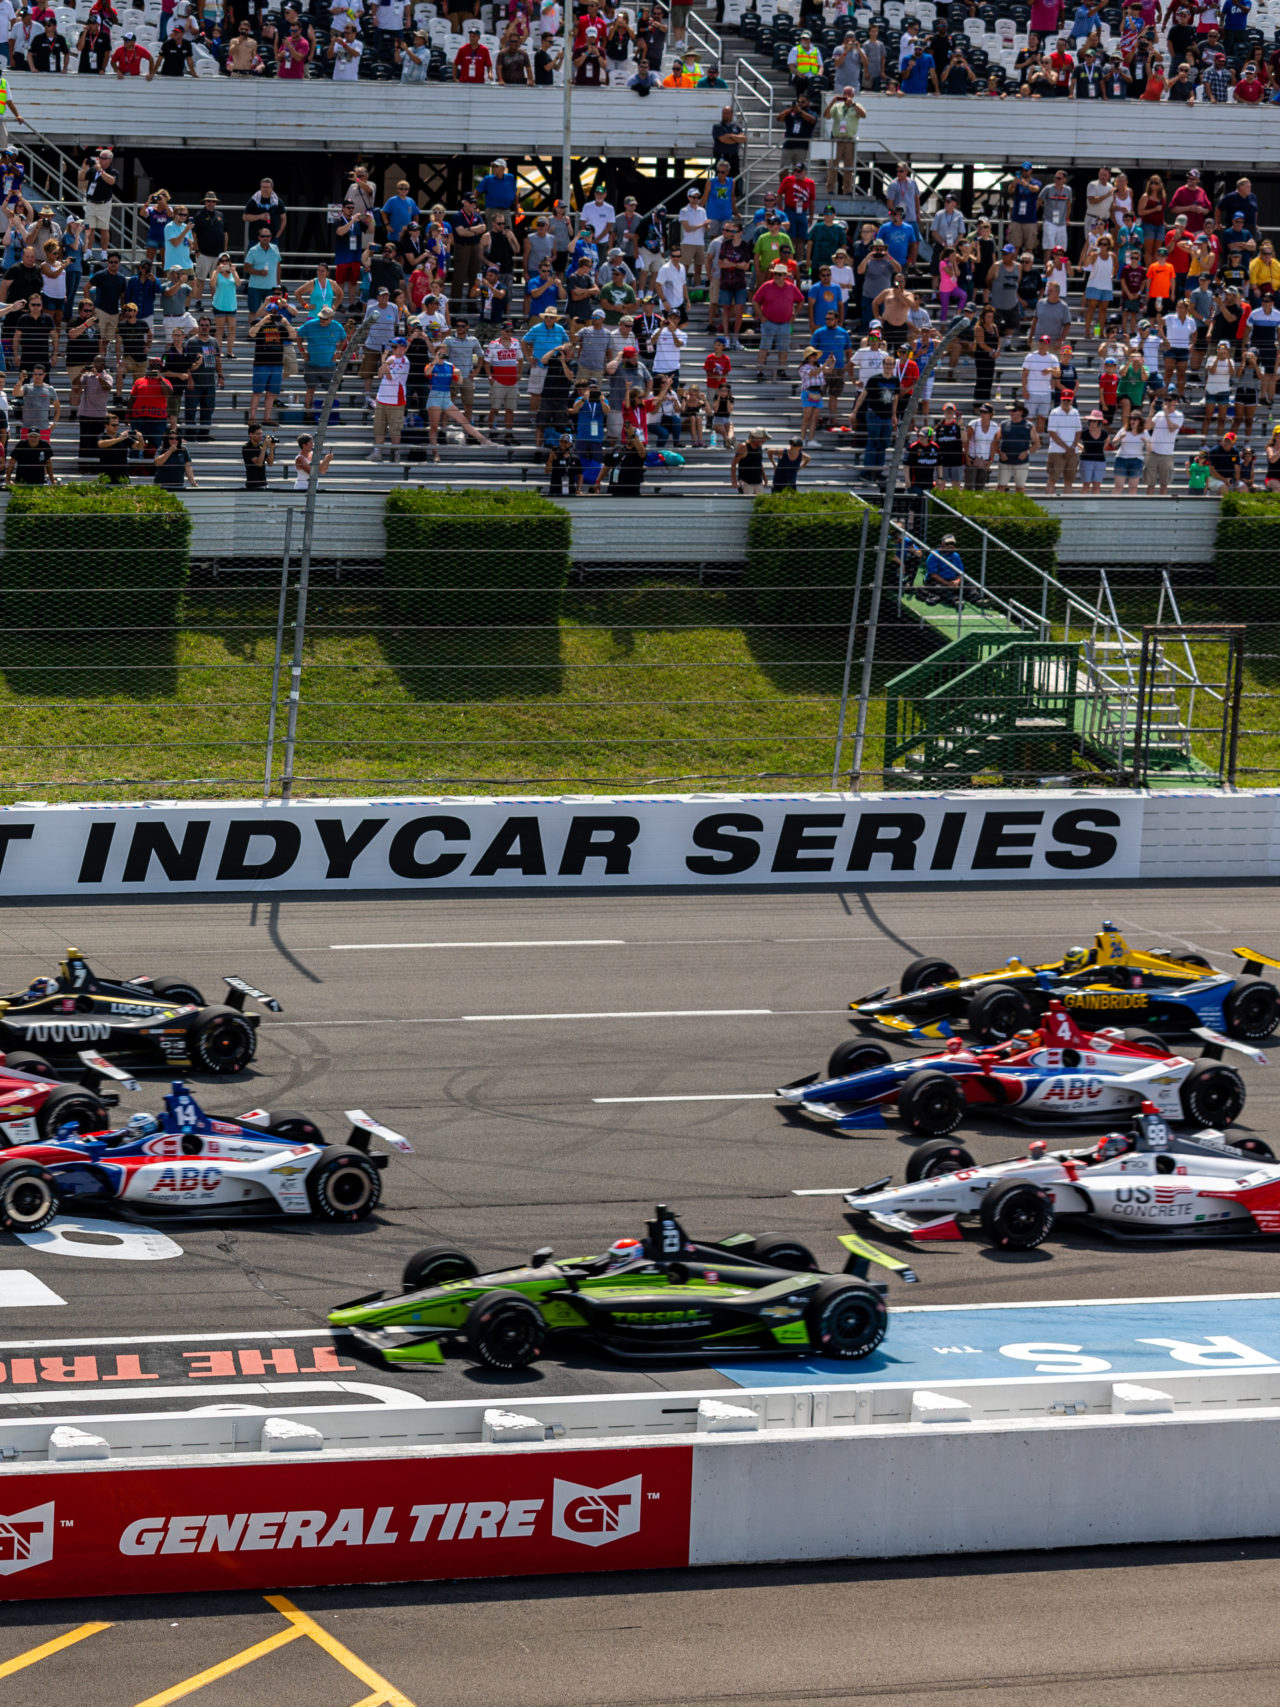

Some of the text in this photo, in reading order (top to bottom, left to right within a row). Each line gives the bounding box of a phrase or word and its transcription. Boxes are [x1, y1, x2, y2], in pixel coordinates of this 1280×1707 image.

[77, 815, 640, 883] INDYCAR
[685, 808, 1121, 876] SERIES
[73, 968, 87, 987] 7
[110, 1002, 151, 1016] LUCAS
[1064, 993, 1149, 1010] GAINBRIDGE
[25, 1023, 111, 1042] ARROW
[1057, 1022, 1072, 1041] 4
[1040, 1078, 1104, 1100] ABC
[174, 1105, 197, 1126] 14
[1147, 1125, 1167, 1145] 98
[148, 1167, 223, 1192] ABC
[1116, 1185, 1151, 1204] US
[1112, 1202, 1195, 1218] CONCRETE
[182, 1347, 357, 1378] THE
[119, 1506, 401, 1556] GENERAL
[409, 1498, 545, 1543] TIRE
